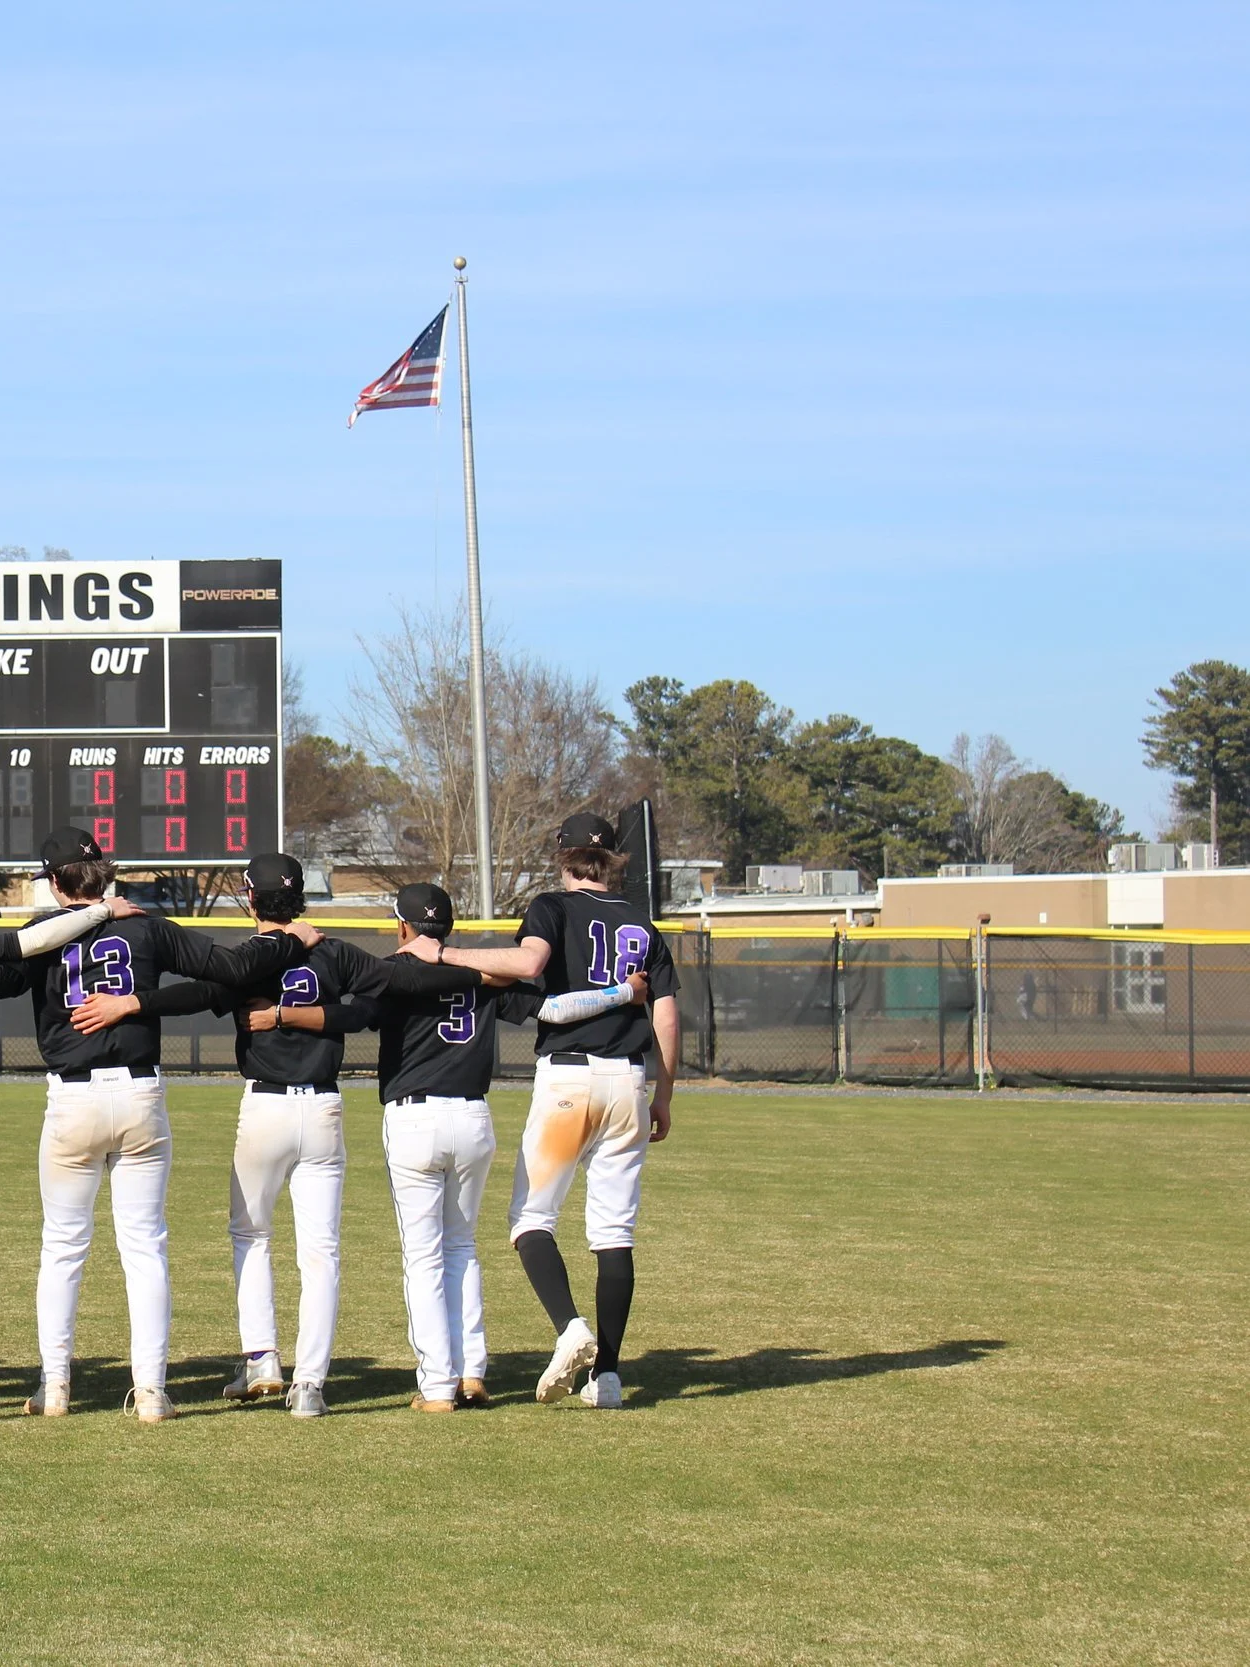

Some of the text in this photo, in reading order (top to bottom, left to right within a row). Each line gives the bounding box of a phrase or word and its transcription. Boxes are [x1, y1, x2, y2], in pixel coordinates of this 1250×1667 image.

[182, 589, 277, 601] POWERADE
[90, 647, 150, 675] OUT
[10, 749, 31, 767] 10
[69, 746, 271, 766] RUNS HITS ERRORS
[94, 769, 247, 805] 0 0 0
[93, 817, 247, 853] 8 0 0
[588, 920, 650, 986] 18
[61, 935, 135, 1009] 13
[280, 966, 319, 1007] 2
[437, 986, 476, 1044] 3
